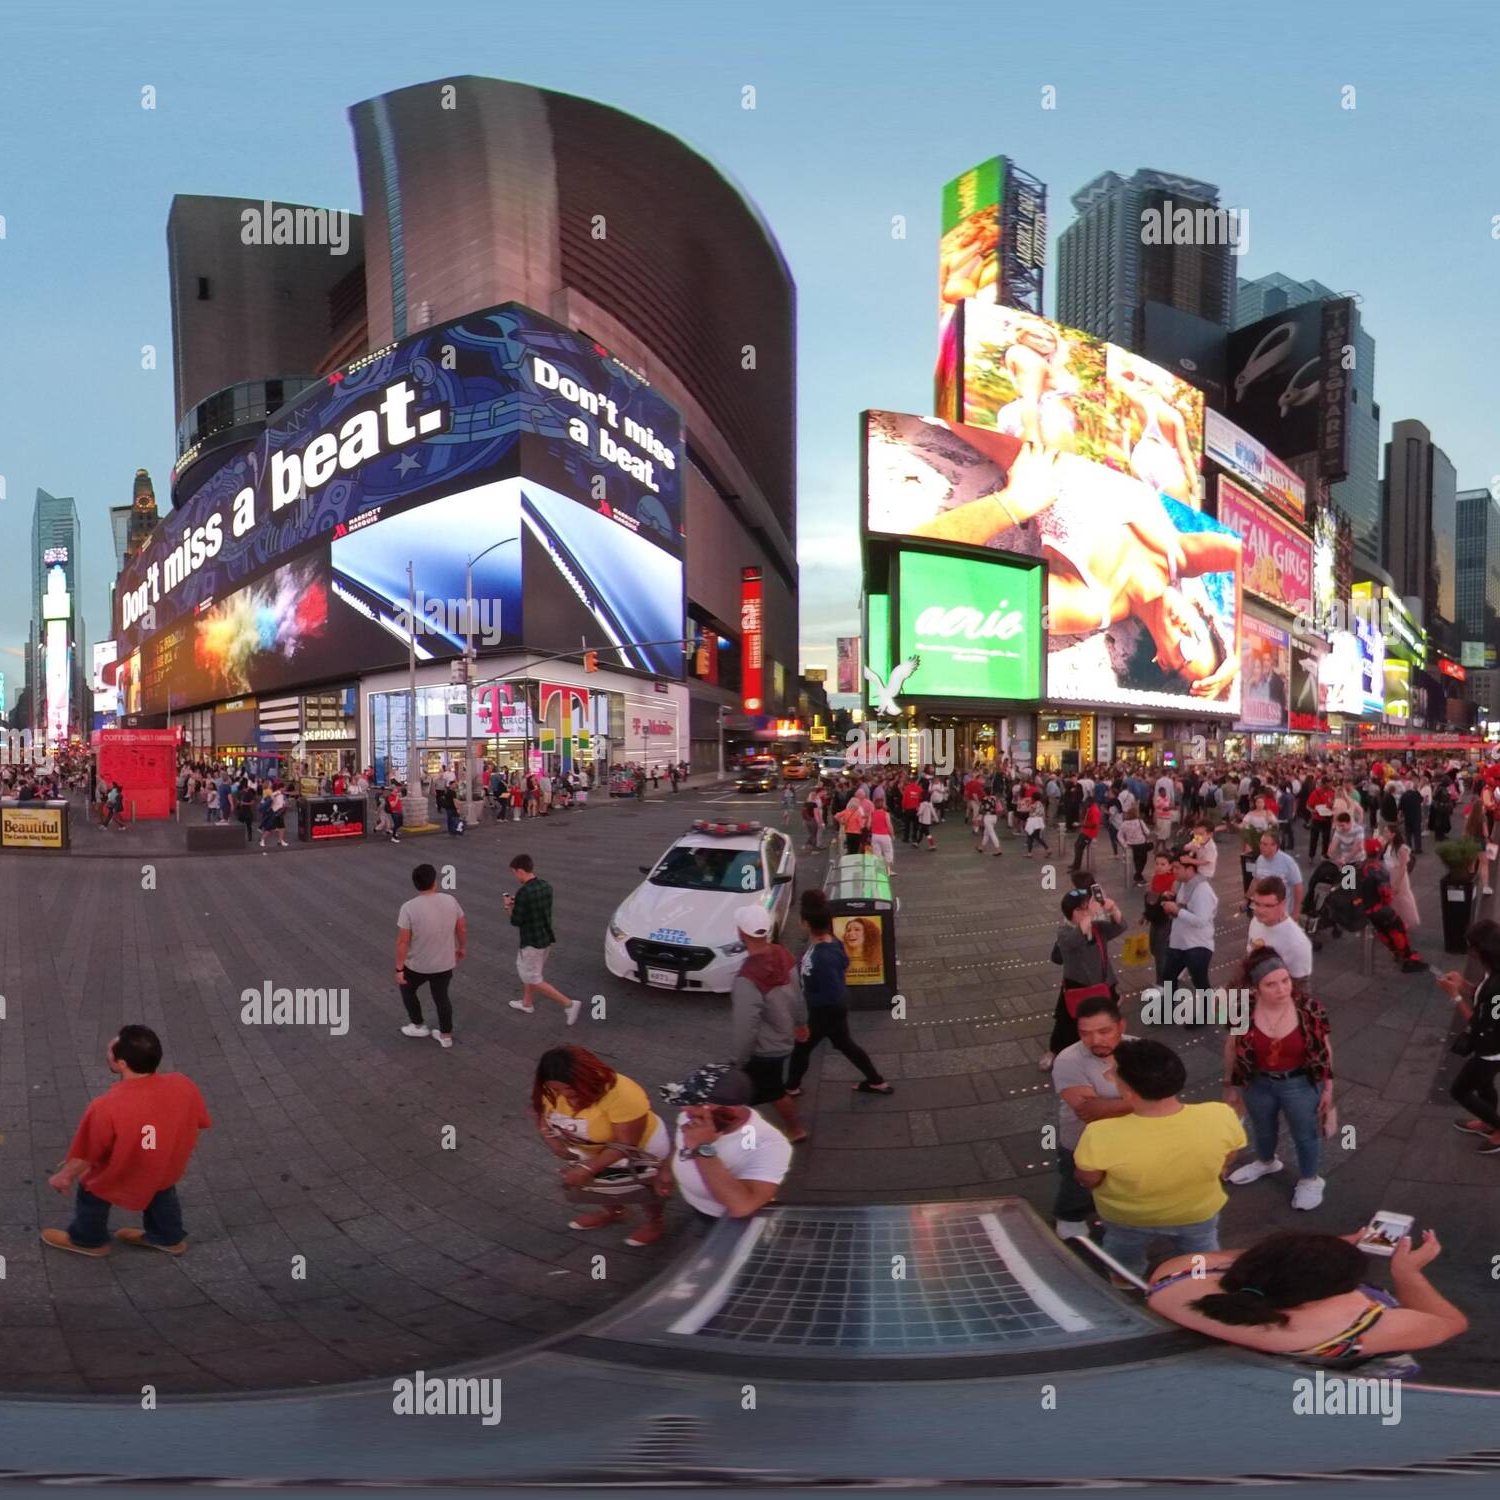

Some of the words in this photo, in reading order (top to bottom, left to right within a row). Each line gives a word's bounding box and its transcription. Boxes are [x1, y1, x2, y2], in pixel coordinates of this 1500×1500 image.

[349, 343, 398, 371] MARRIOTT
[534, 357, 619, 429] Don't
[623, 416, 676, 470] miss
[1325, 367, 1344, 450] SQUARE
[569, 418, 589, 447] a
[600, 428, 660, 493] beat.
[122, 561, 161, 631] Don't
[164, 514, 224, 595] miss
[233, 485, 255, 537] a
[271, 381, 442, 513] beat.
[349, 507, 381, 526] MARRIOTT
[349, 515, 378, 533] MARQUIS
[1273, 541, 1309, 586] GIRLS
[916, 600, 1023, 640] aerie
[304, 728, 348, 741] SEPHORA
[4, 820, 59, 834] Beautiful
[649, 932, 692, 945] POLICE
[659, 927, 687, 937] NYPD
